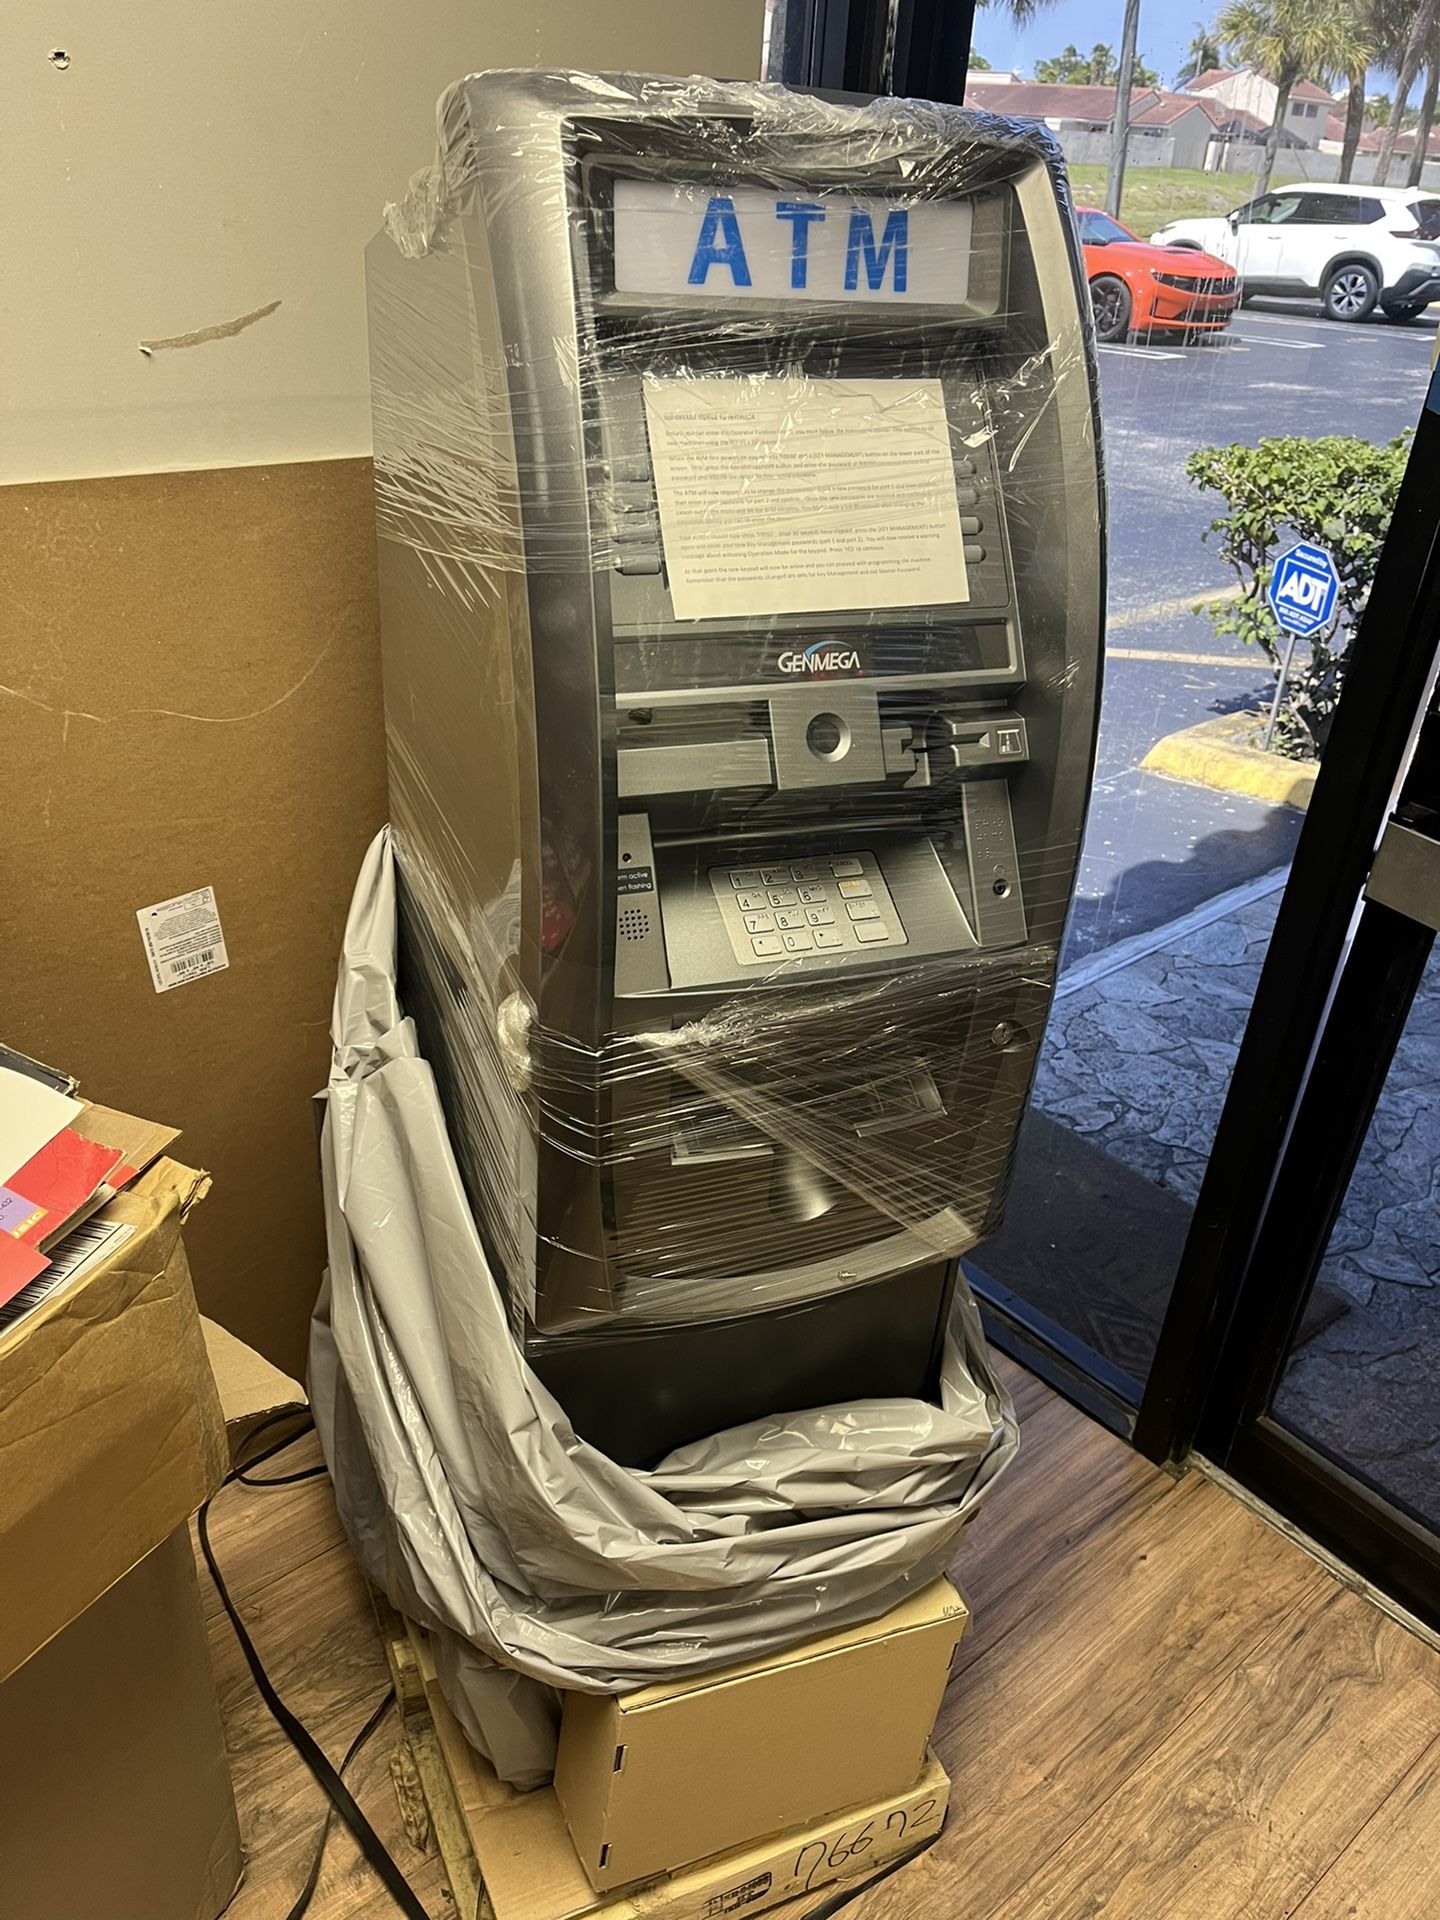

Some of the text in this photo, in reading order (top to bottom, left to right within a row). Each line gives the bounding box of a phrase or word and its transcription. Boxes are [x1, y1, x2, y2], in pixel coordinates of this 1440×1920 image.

[687, 197, 909, 293] ATM
[747, 550, 773, 558] Operation
[808, 547, 829, 555] keypad.
[740, 565, 759, 573] keypad
[835, 560, 856, 568] proceed
[867, 558, 900, 566] programming
[737, 575, 764, 583] passwords
[764, 573, 787, 581] changed
[826, 569, 859, 578] Management
[1279, 570, 1329, 612] ADT
[777, 651, 861, 674] GENMEGA
[629, 872, 648, 880] active
[765, 872, 773, 883] 2
[796, 870, 804, 880] 3
[628, 882, 652, 890] flashing
[735, 877, 742, 886] 1
[772, 894, 781, 905] 5
[802, 890, 811, 901] 6
[743, 898, 750, 908] 4
[780, 916, 789, 927] 8
[810, 912, 819, 923] 9
[749, 920, 756, 931] 7
[787, 936, 795, 947] 0
